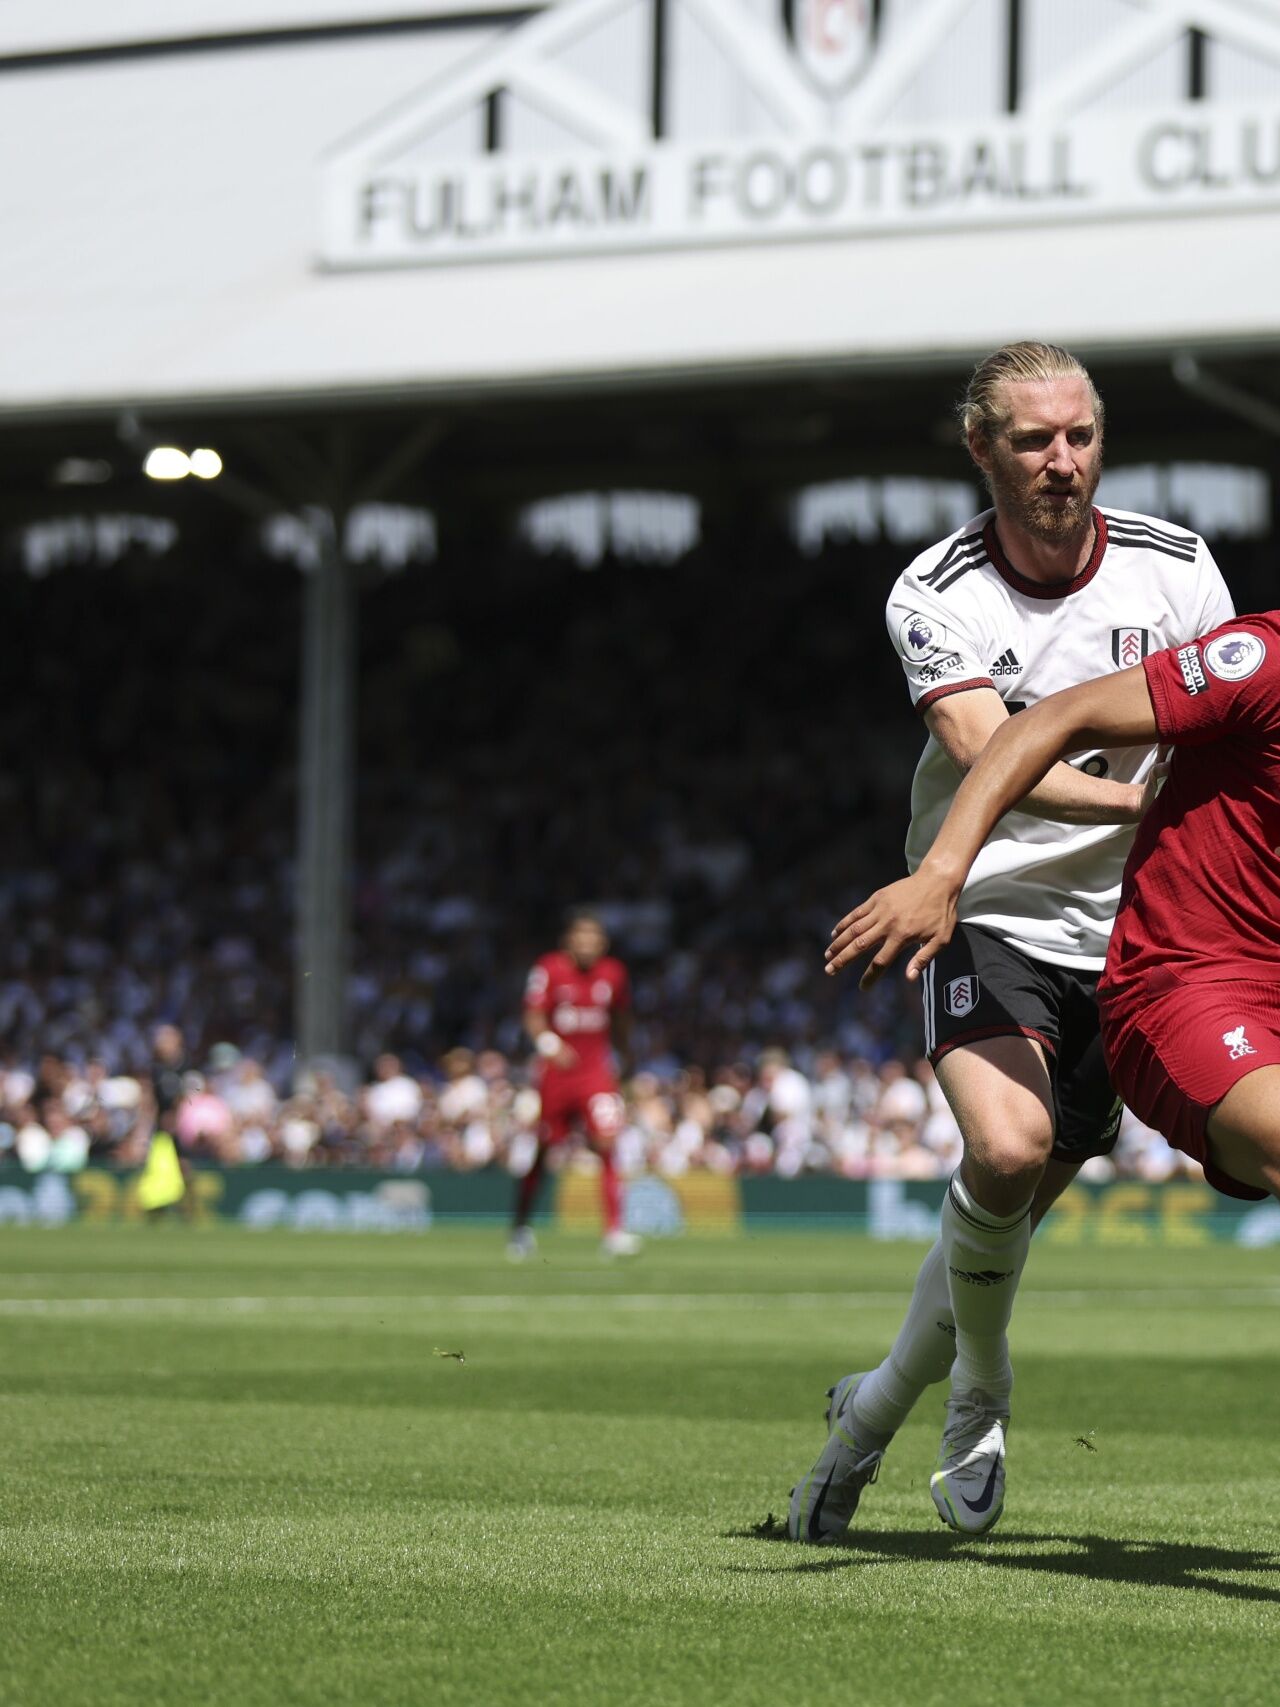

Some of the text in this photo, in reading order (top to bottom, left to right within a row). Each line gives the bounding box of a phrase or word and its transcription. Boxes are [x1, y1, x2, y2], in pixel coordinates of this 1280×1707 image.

[358, 165, 648, 243] FULHAM
[688, 133, 1088, 222] FOOTBALL
[988, 663, 1023, 677] adidas
[1189, 656, 1206, 688] room
